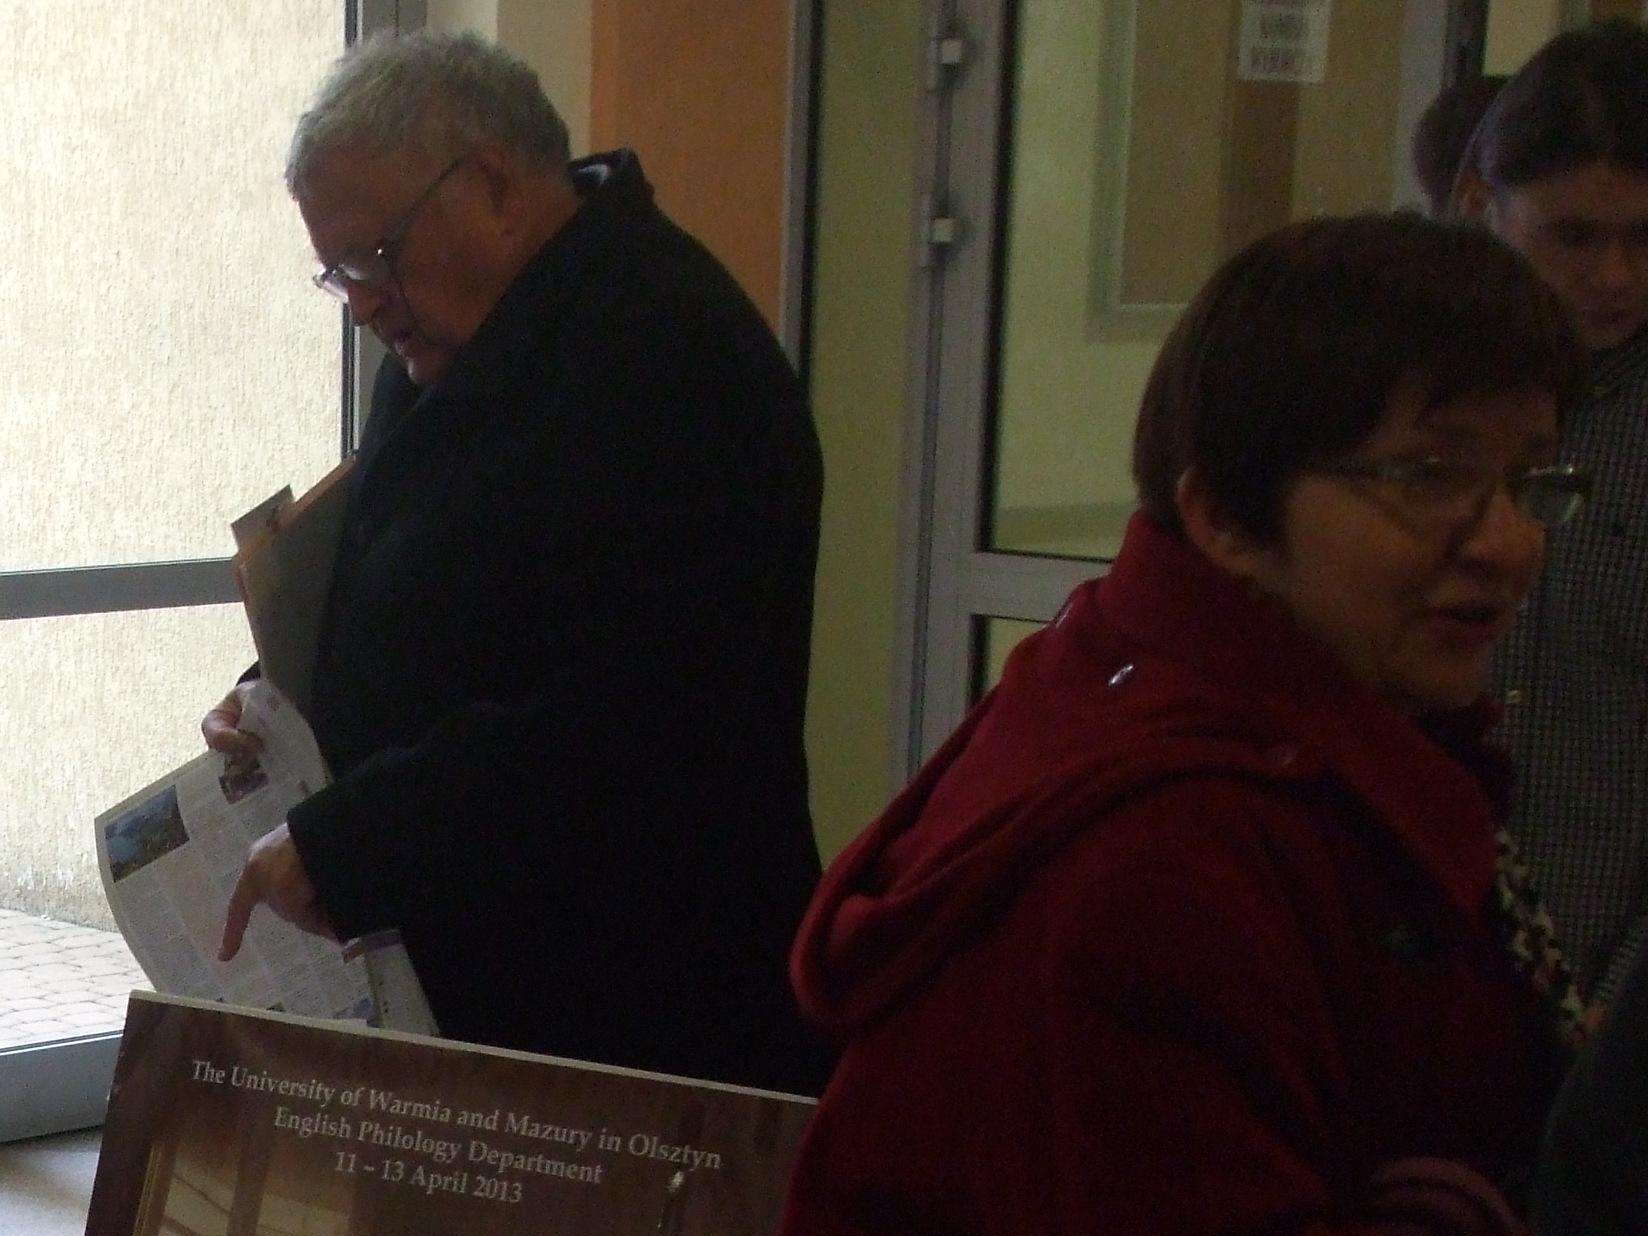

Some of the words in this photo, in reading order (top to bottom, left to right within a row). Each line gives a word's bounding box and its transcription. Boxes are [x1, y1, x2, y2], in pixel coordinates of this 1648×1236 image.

[192, 1060, 225, 1084] The
[231, 1065, 336, 1107] University
[340, 1086, 365, 1106] of
[369, 1089, 451, 1123] Warmia
[456, 1109, 500, 1131] and
[504, 1112, 593, 1150] Mazury
[599, 1128, 622, 1151] in
[628, 1133, 722, 1171] Olsztyn
[274, 1106, 352, 1138] English
[358, 1120, 462, 1164] Philology
[468, 1140, 602, 1184] Department
[334, 1151, 356, 1173] 11
[381, 1159, 404, 1182] 13
[410, 1165, 468, 1195] April
[473, 1175, 523, 1203] 2013
